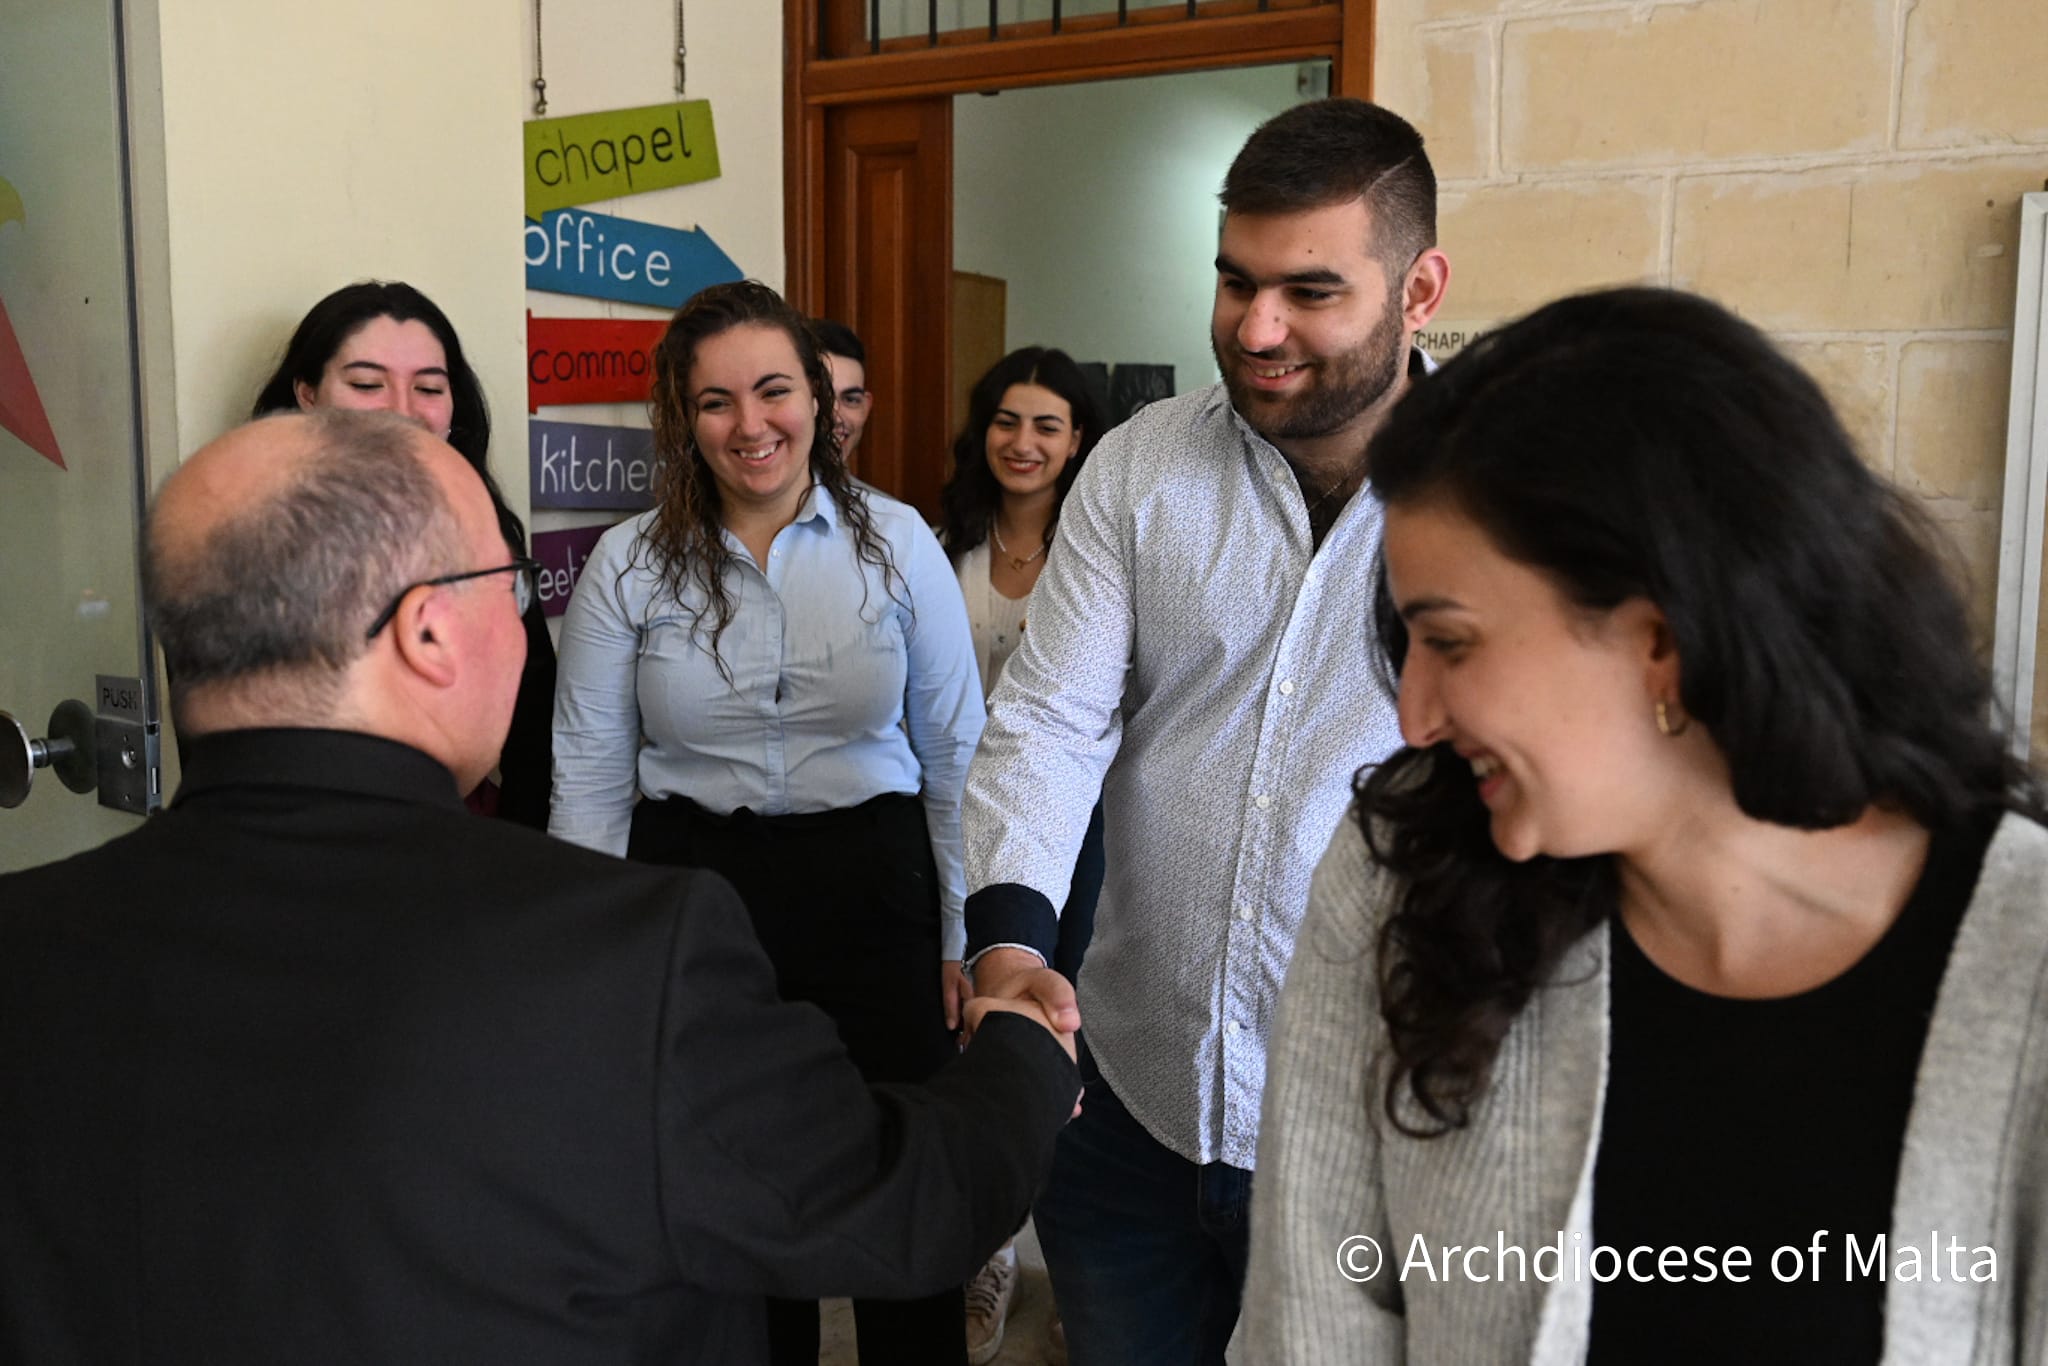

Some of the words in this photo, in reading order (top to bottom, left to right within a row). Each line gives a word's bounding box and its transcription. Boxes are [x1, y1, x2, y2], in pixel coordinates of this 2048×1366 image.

[535, 110, 692, 189] chapel
[525, 213, 671, 287] office
[530, 350, 652, 384] commo
[103, 688, 137, 710] PUSH
